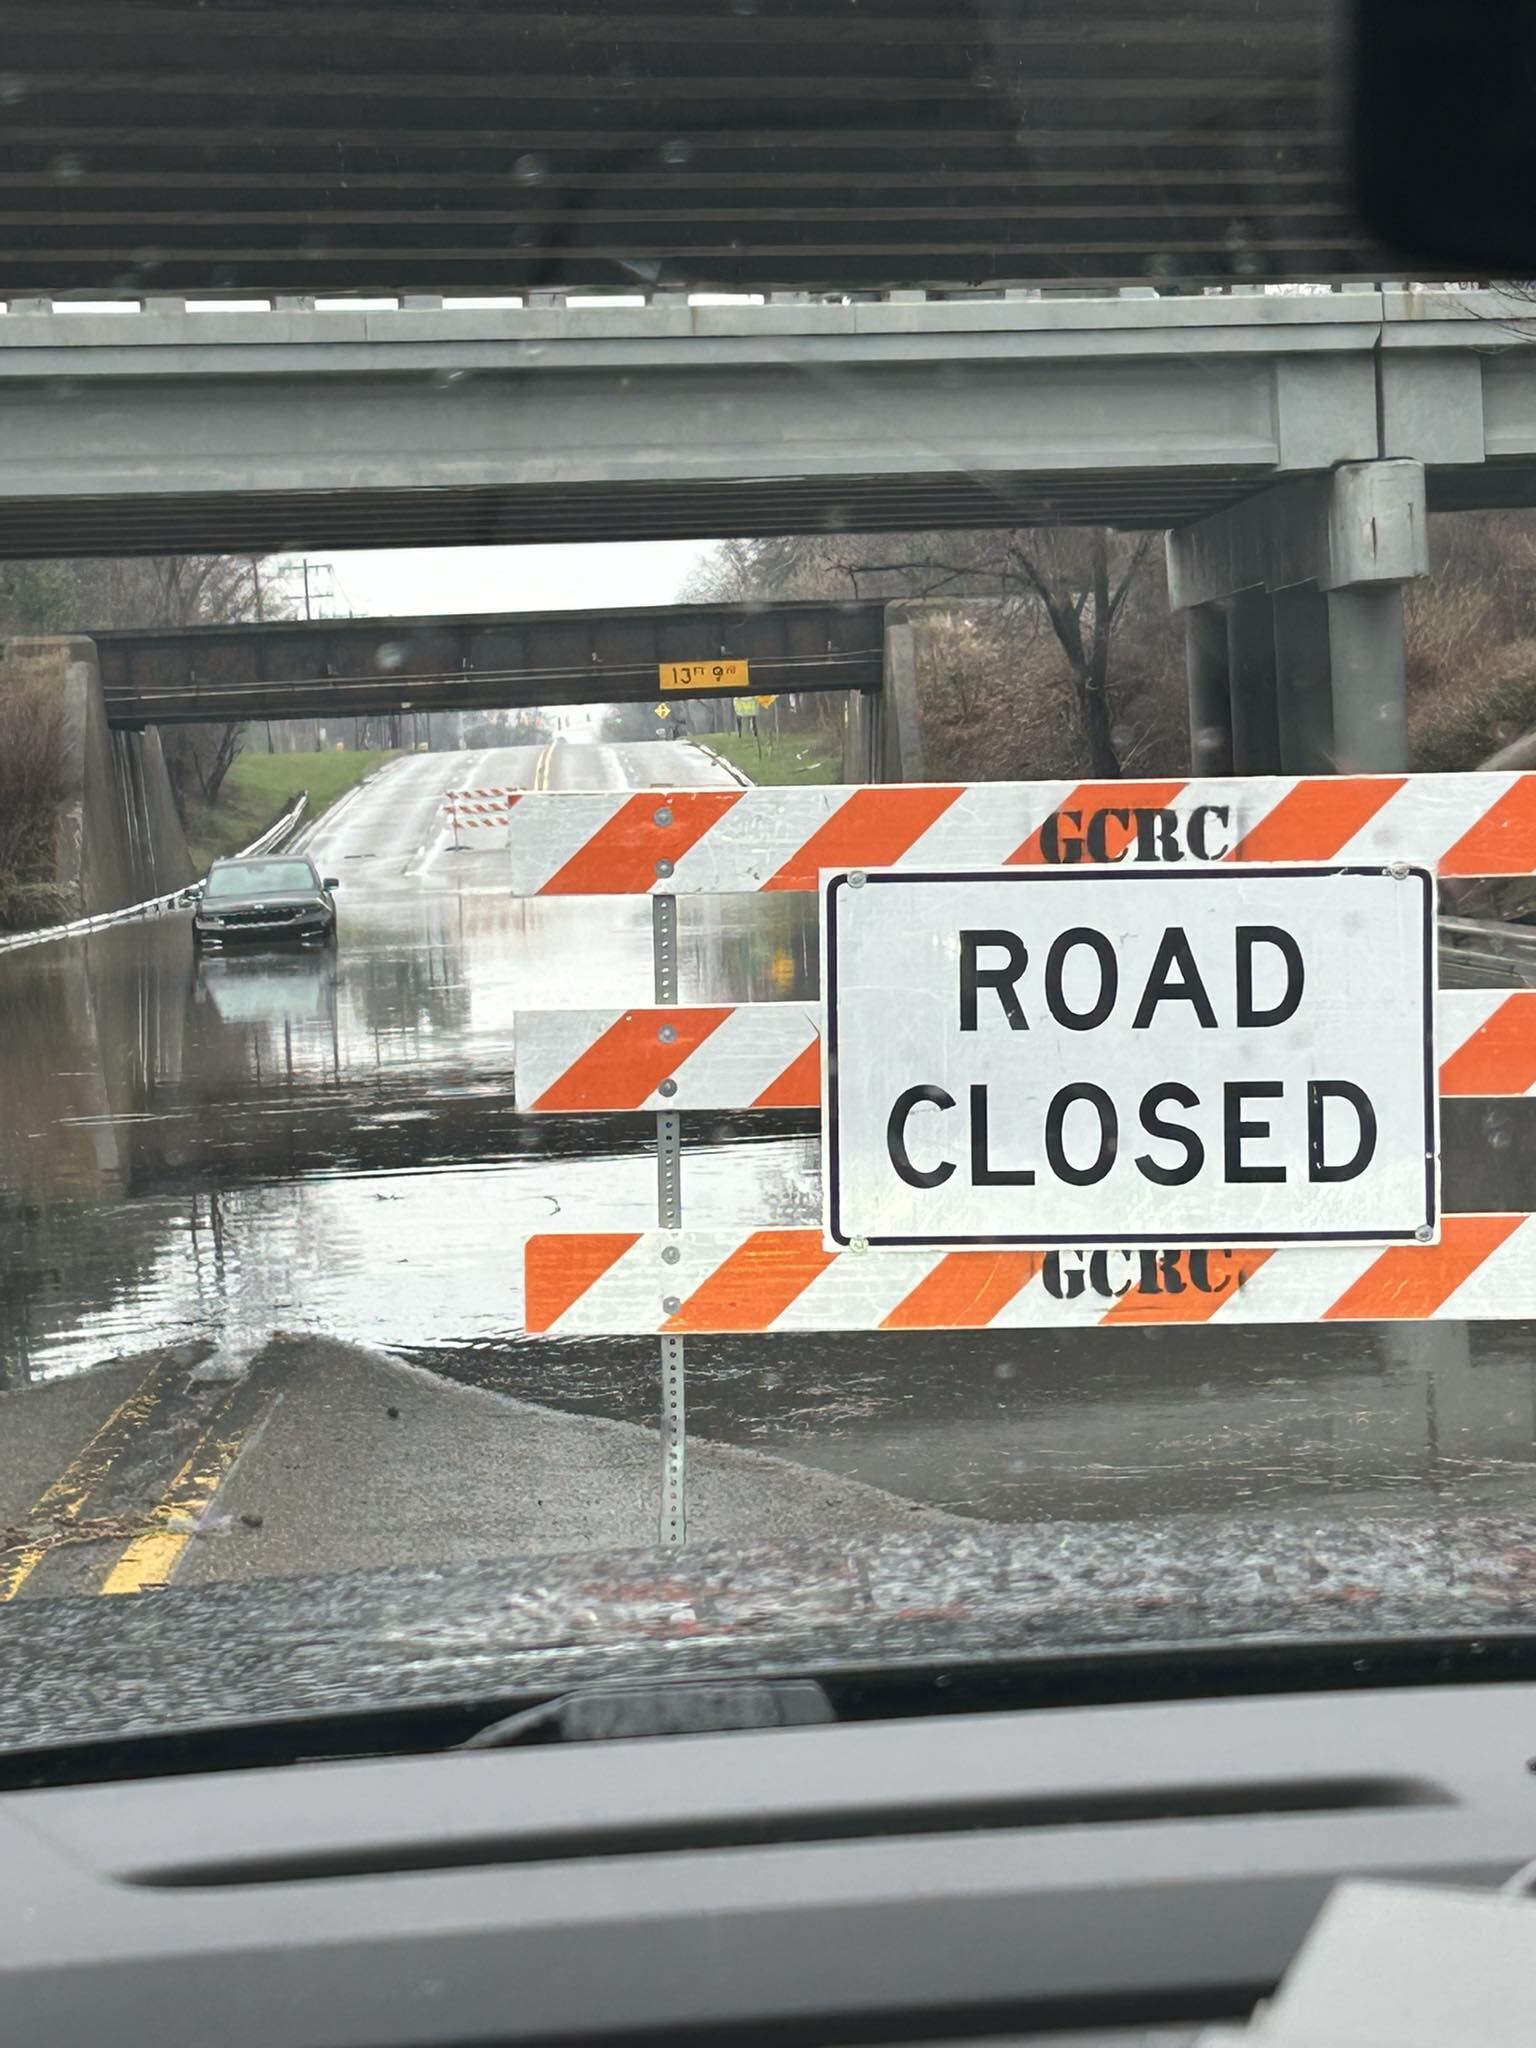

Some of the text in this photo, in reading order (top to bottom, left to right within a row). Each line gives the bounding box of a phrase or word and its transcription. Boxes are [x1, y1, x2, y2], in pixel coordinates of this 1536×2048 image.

[1040, 805, 1230, 864] GCRC
[959, 925, 1305, 1032] ROAD
[886, 1079, 1378, 1189] CLOSED
[1042, 1249, 1232, 1299] GCRC
